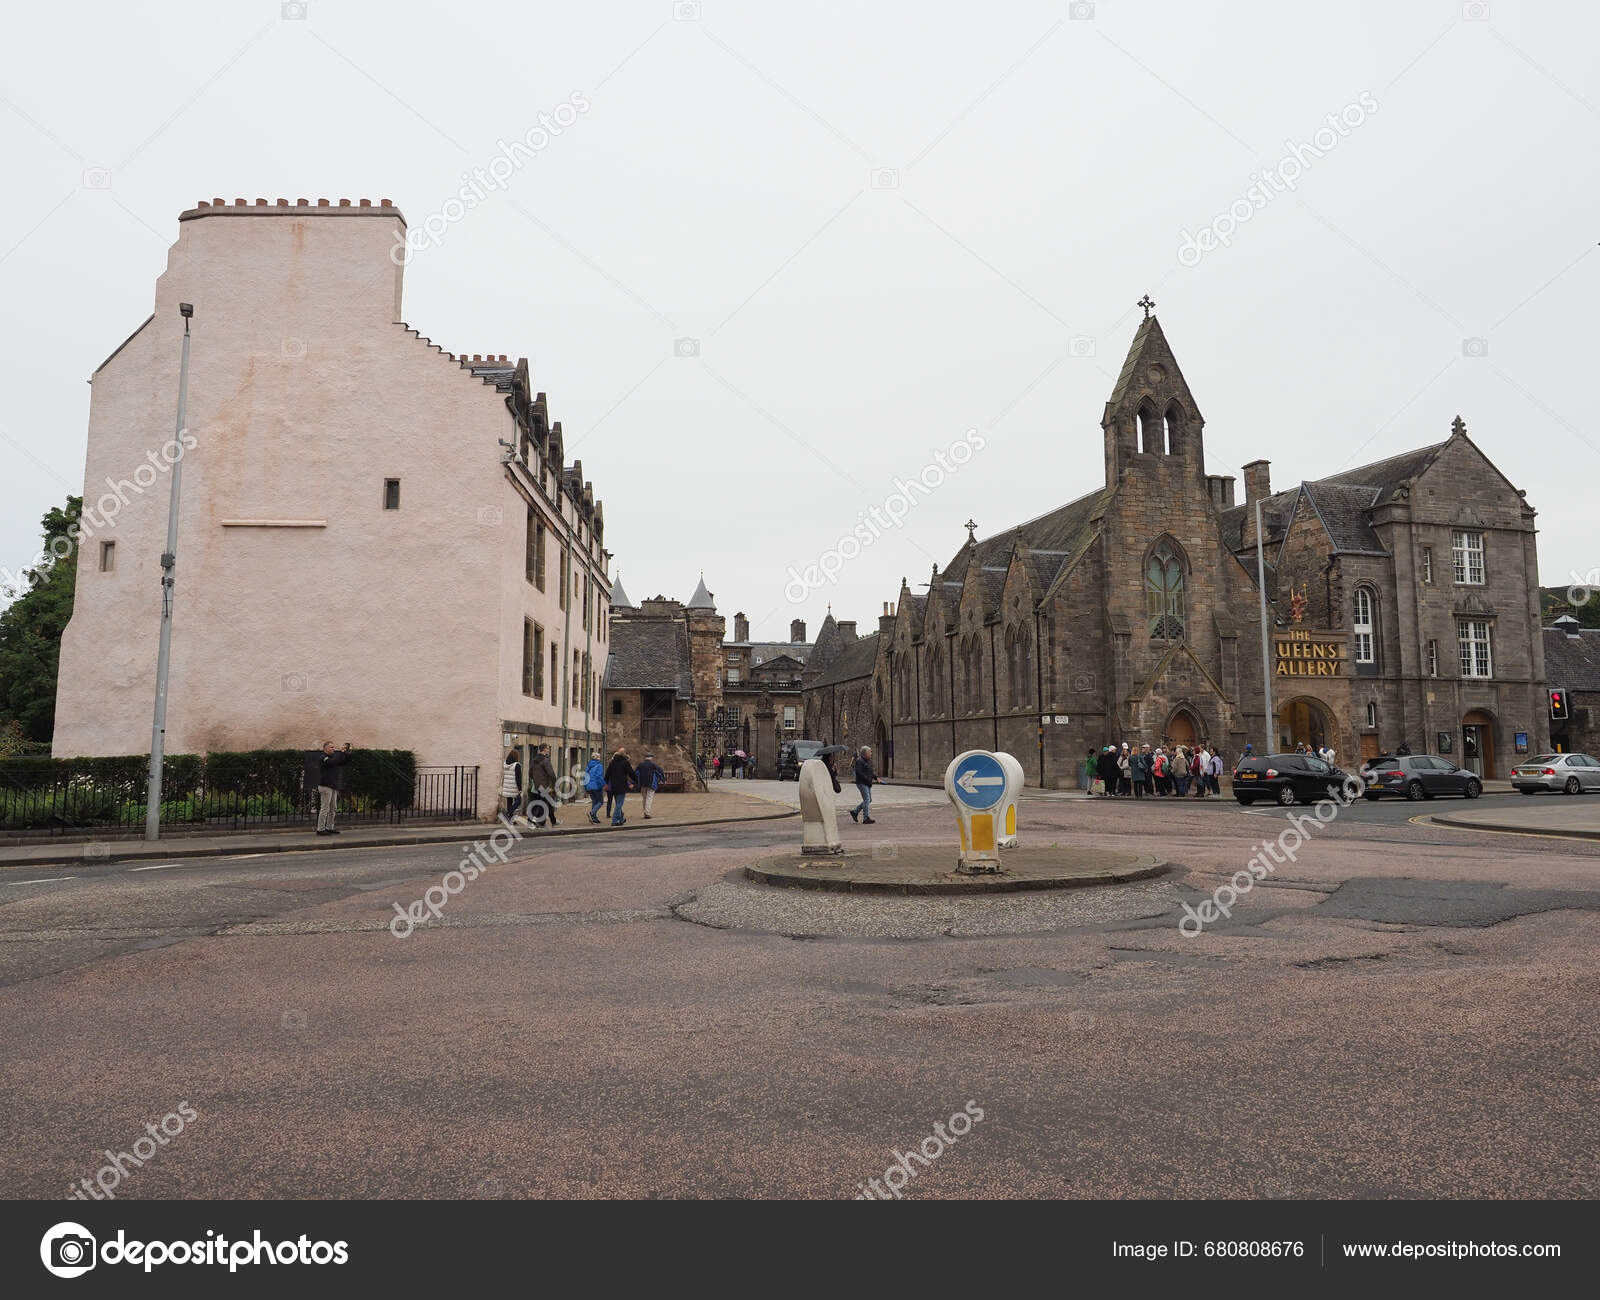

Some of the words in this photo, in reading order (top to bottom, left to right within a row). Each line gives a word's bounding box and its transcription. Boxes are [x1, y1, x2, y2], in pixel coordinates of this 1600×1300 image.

[1289, 631, 1310, 640] THE
[1276, 643, 1337, 658] UEEN'S
[1276, 661, 1338, 675] ALLERY
